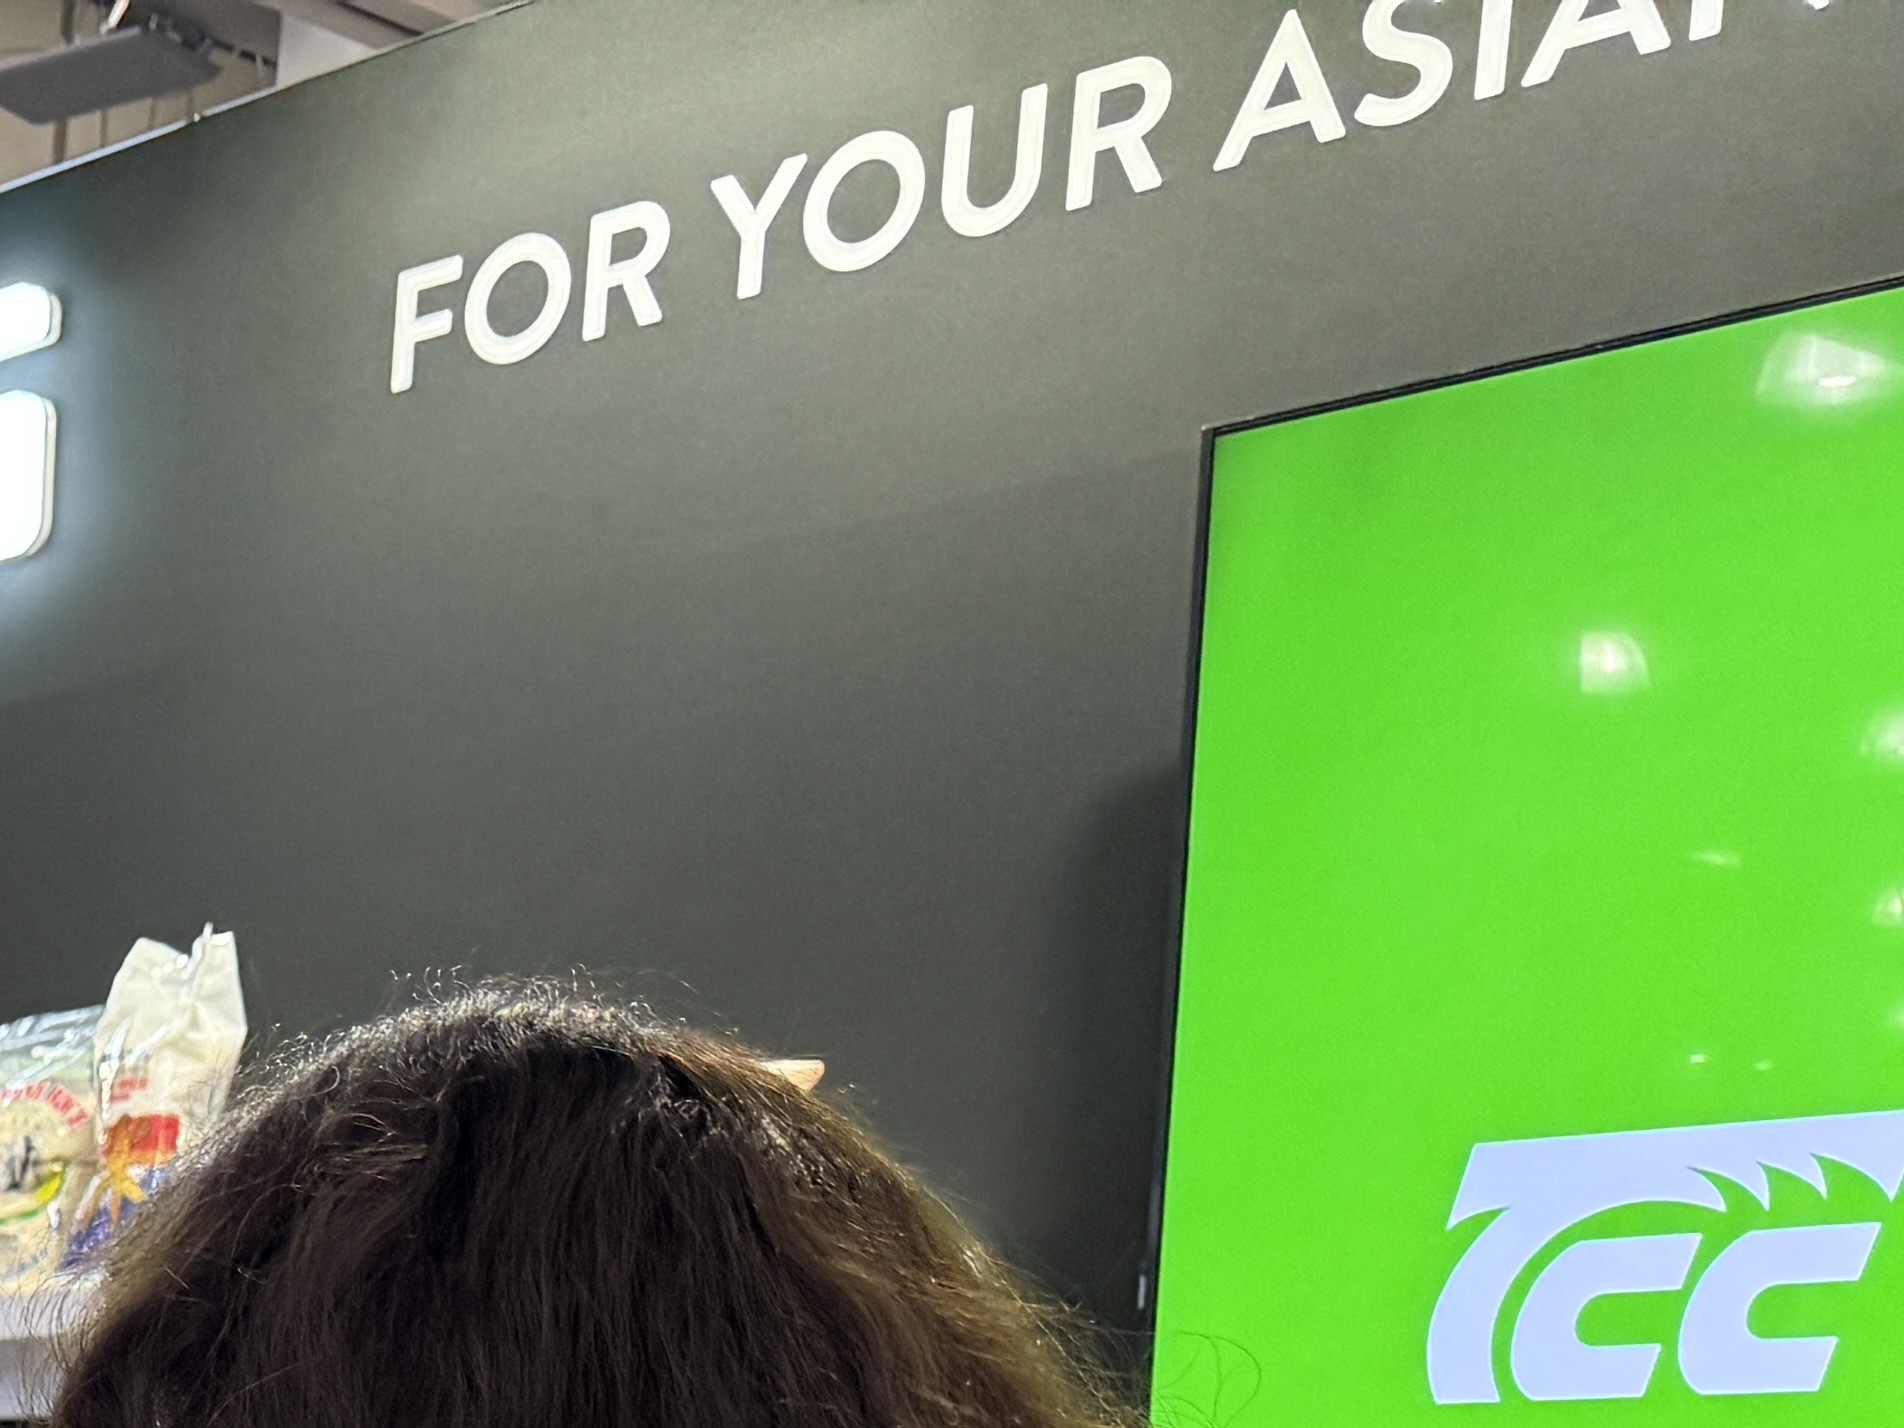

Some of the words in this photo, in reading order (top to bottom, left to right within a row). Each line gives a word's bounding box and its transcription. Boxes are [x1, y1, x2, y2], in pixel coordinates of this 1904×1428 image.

[390, 199, 671, 393] FOR
[709, 54, 1172, 300] YOUR
[1212, 0, 1832, 172] ASIA
